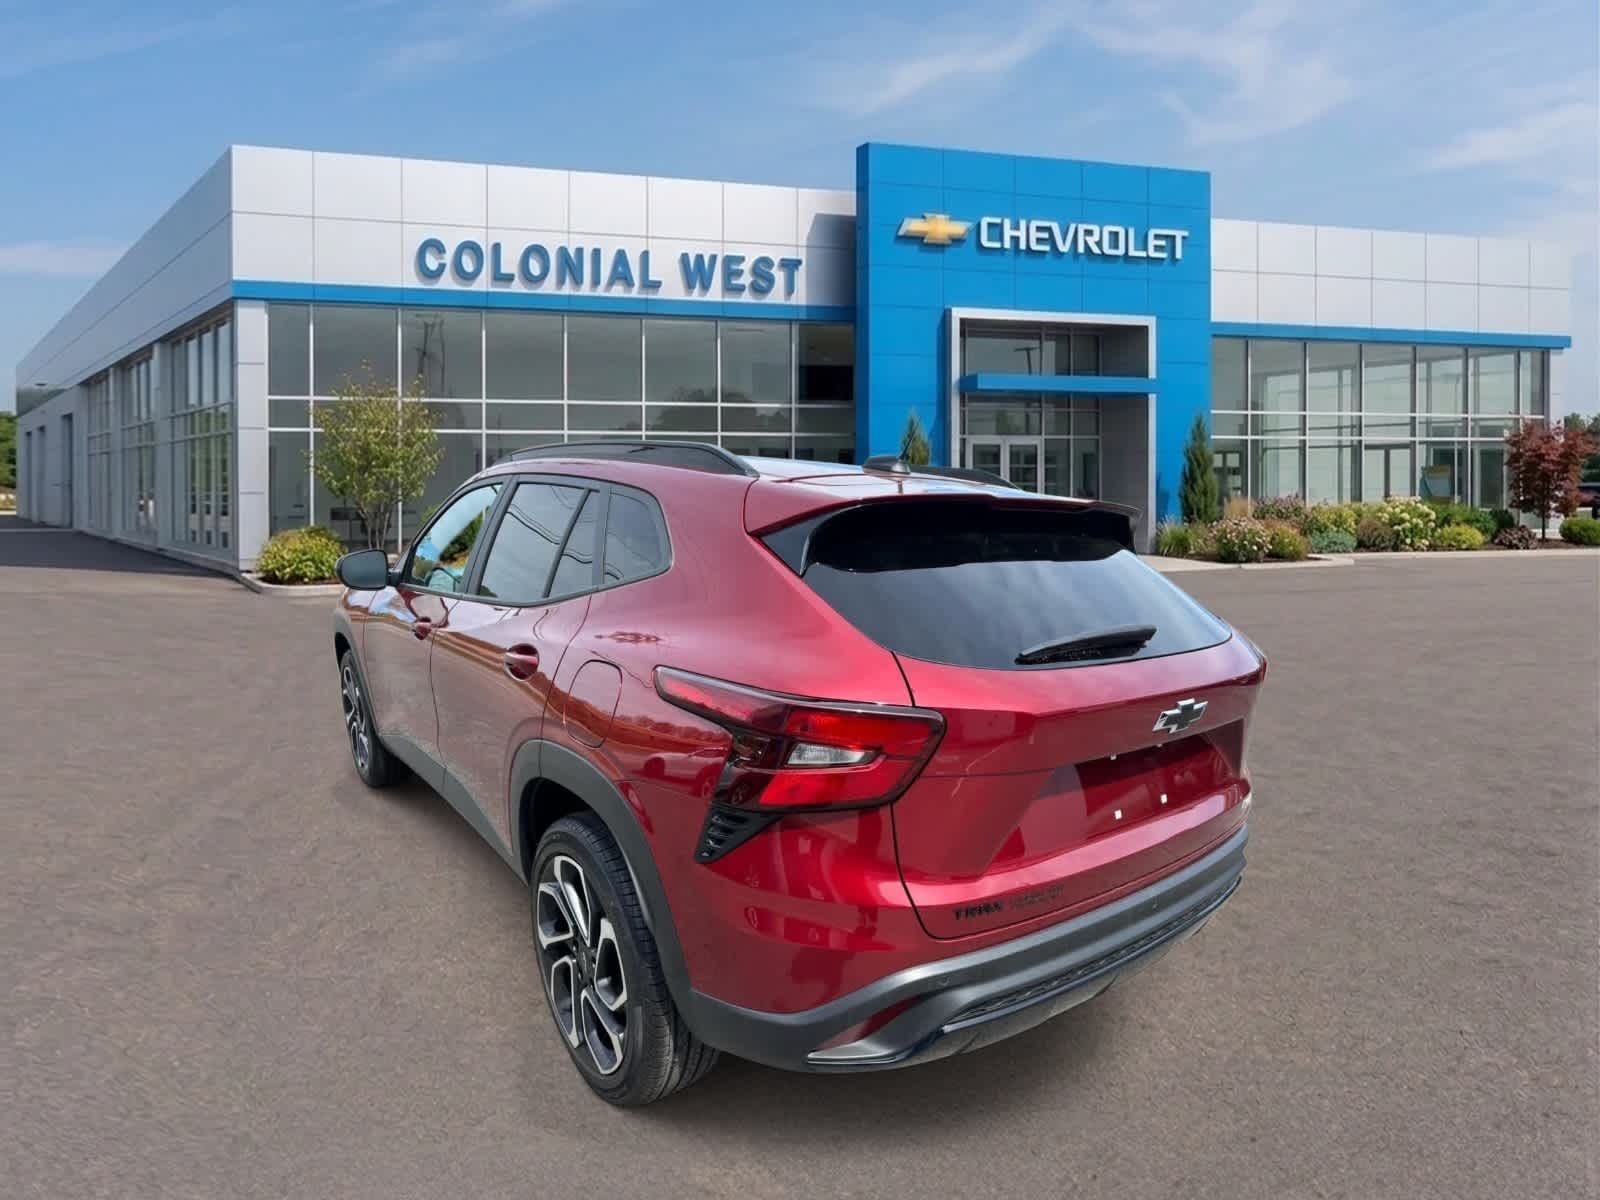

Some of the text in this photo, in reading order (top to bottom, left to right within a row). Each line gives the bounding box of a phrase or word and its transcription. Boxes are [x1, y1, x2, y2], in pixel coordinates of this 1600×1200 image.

[979, 216, 1190, 261] CHEVROLET
[415, 237, 803, 295] COLONIAL WEST
